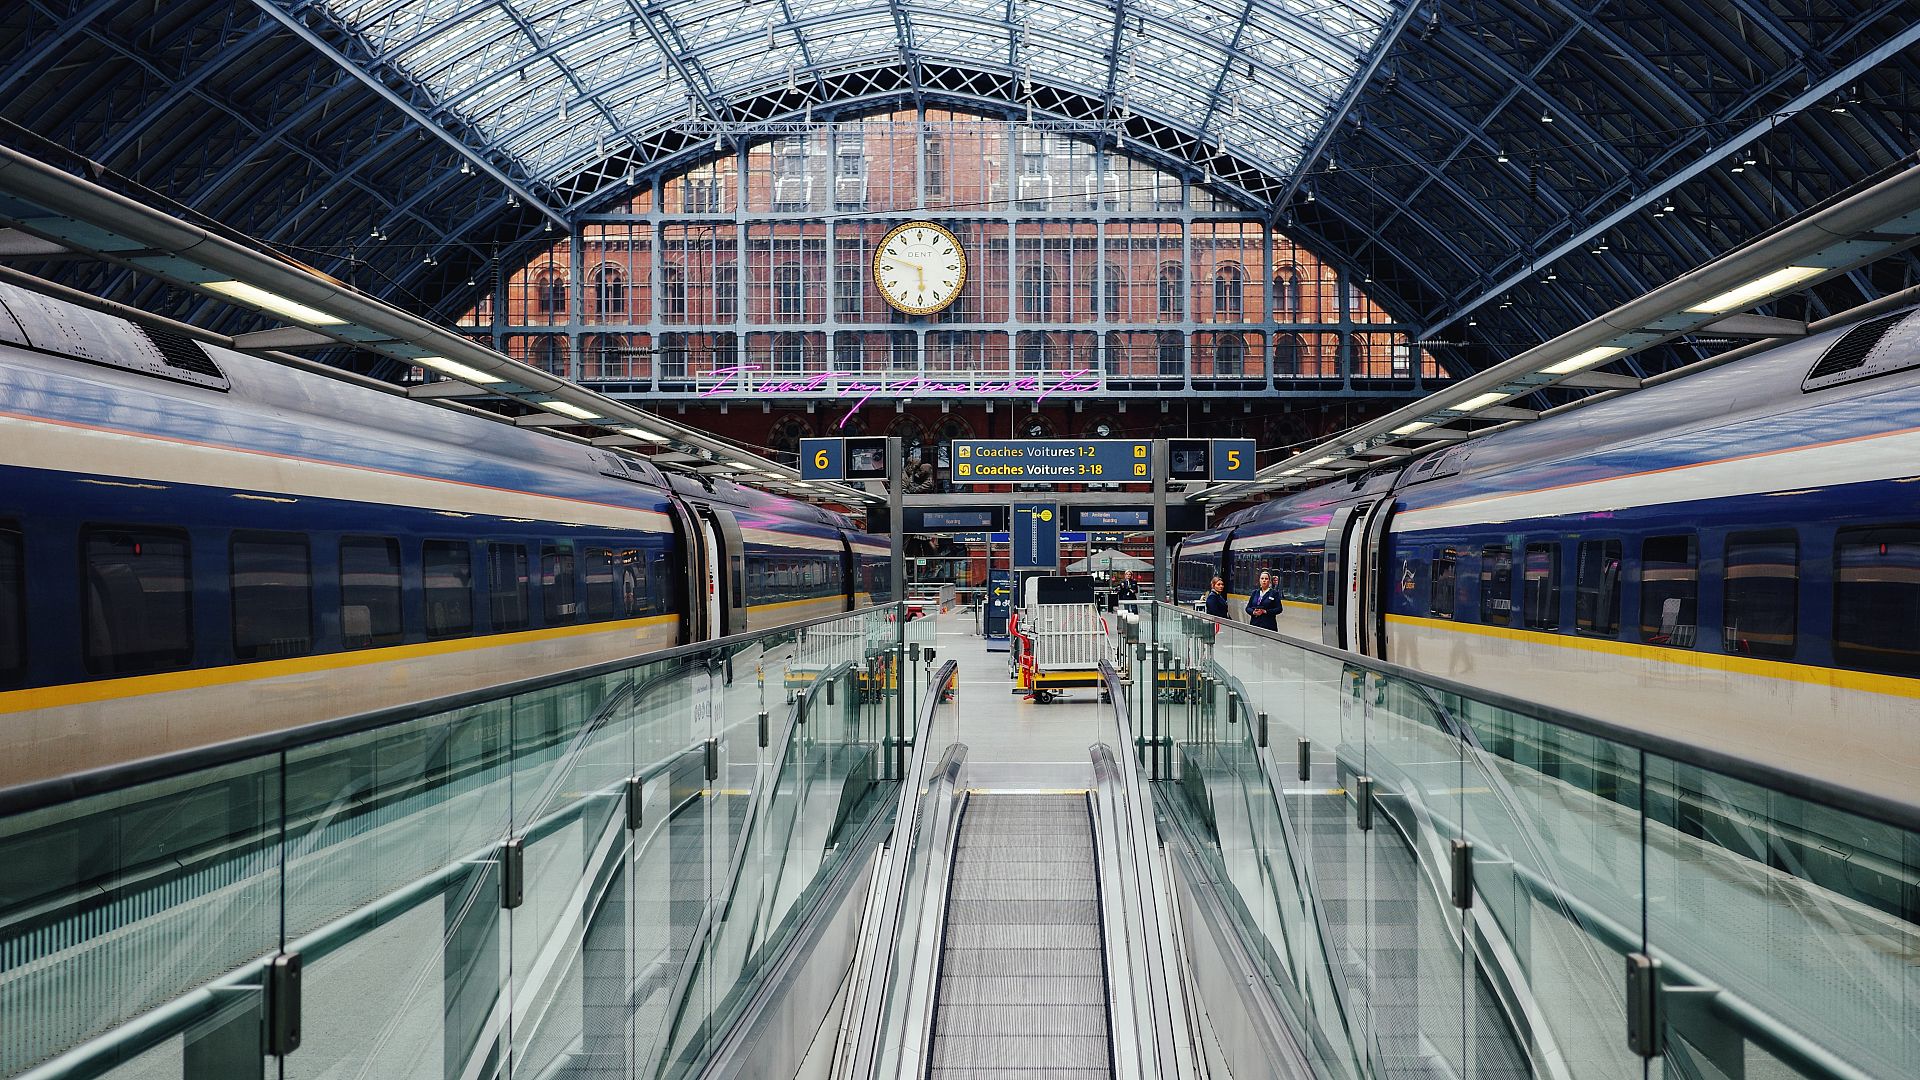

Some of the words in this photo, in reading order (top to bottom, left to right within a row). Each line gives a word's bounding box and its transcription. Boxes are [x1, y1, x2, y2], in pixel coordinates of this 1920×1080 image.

[699, 365, 761, 398] I
[758, 371, 851, 393] want
[839, 380, 881, 429] my
[889, 376, 967, 396] time
[979, 376, 1038, 394] with
[814, 449, 829, 469] 6
[975, 446, 1024, 457] Coaches
[1027, 446, 1075, 457] Voitures
[1078, 446, 1096, 457] 1-2
[1227, 450, 1240, 470] 5
[975, 464, 1024, 475] Coaches
[1027, 464, 1075, 475] Voitures
[1078, 464, 1103, 475] 3-18
